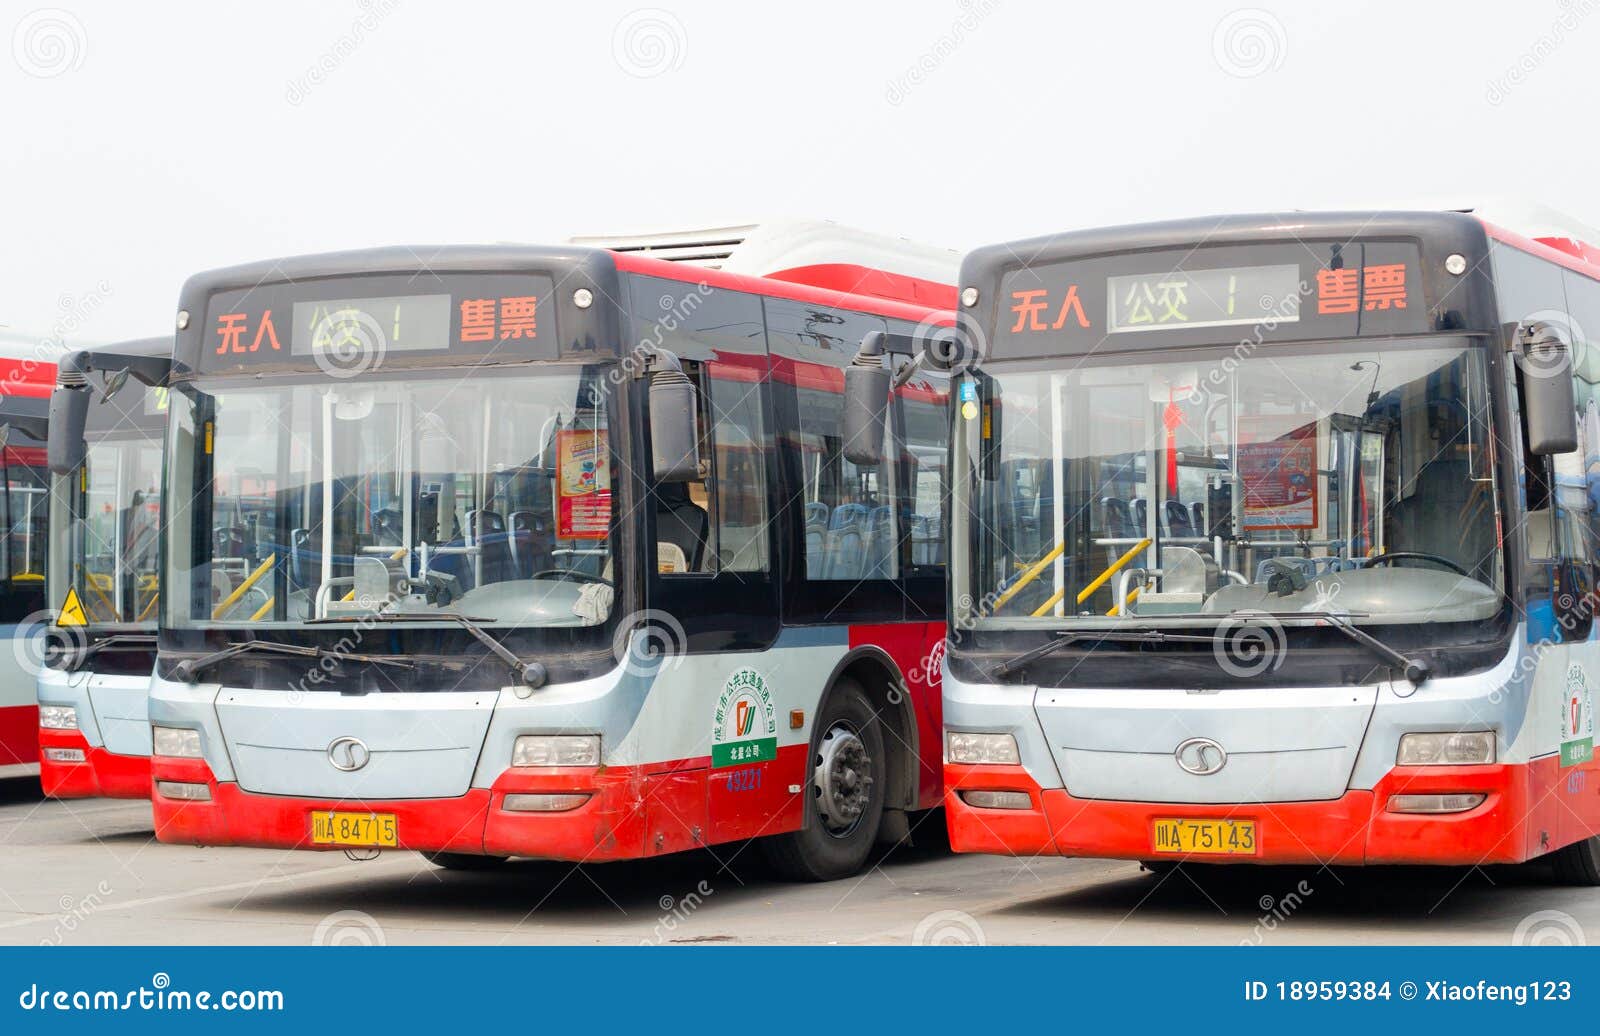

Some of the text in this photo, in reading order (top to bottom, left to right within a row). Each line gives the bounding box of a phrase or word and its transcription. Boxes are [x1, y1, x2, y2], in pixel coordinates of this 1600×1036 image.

[1010, 285, 1090, 333] 无人
[1125, 281, 1189, 324] 公交
[1316, 264, 1407, 314] 售票
[216, 310, 281, 354] 无人
[309, 305, 360, 347] 公交
[460, 296, 537, 342] 售票
